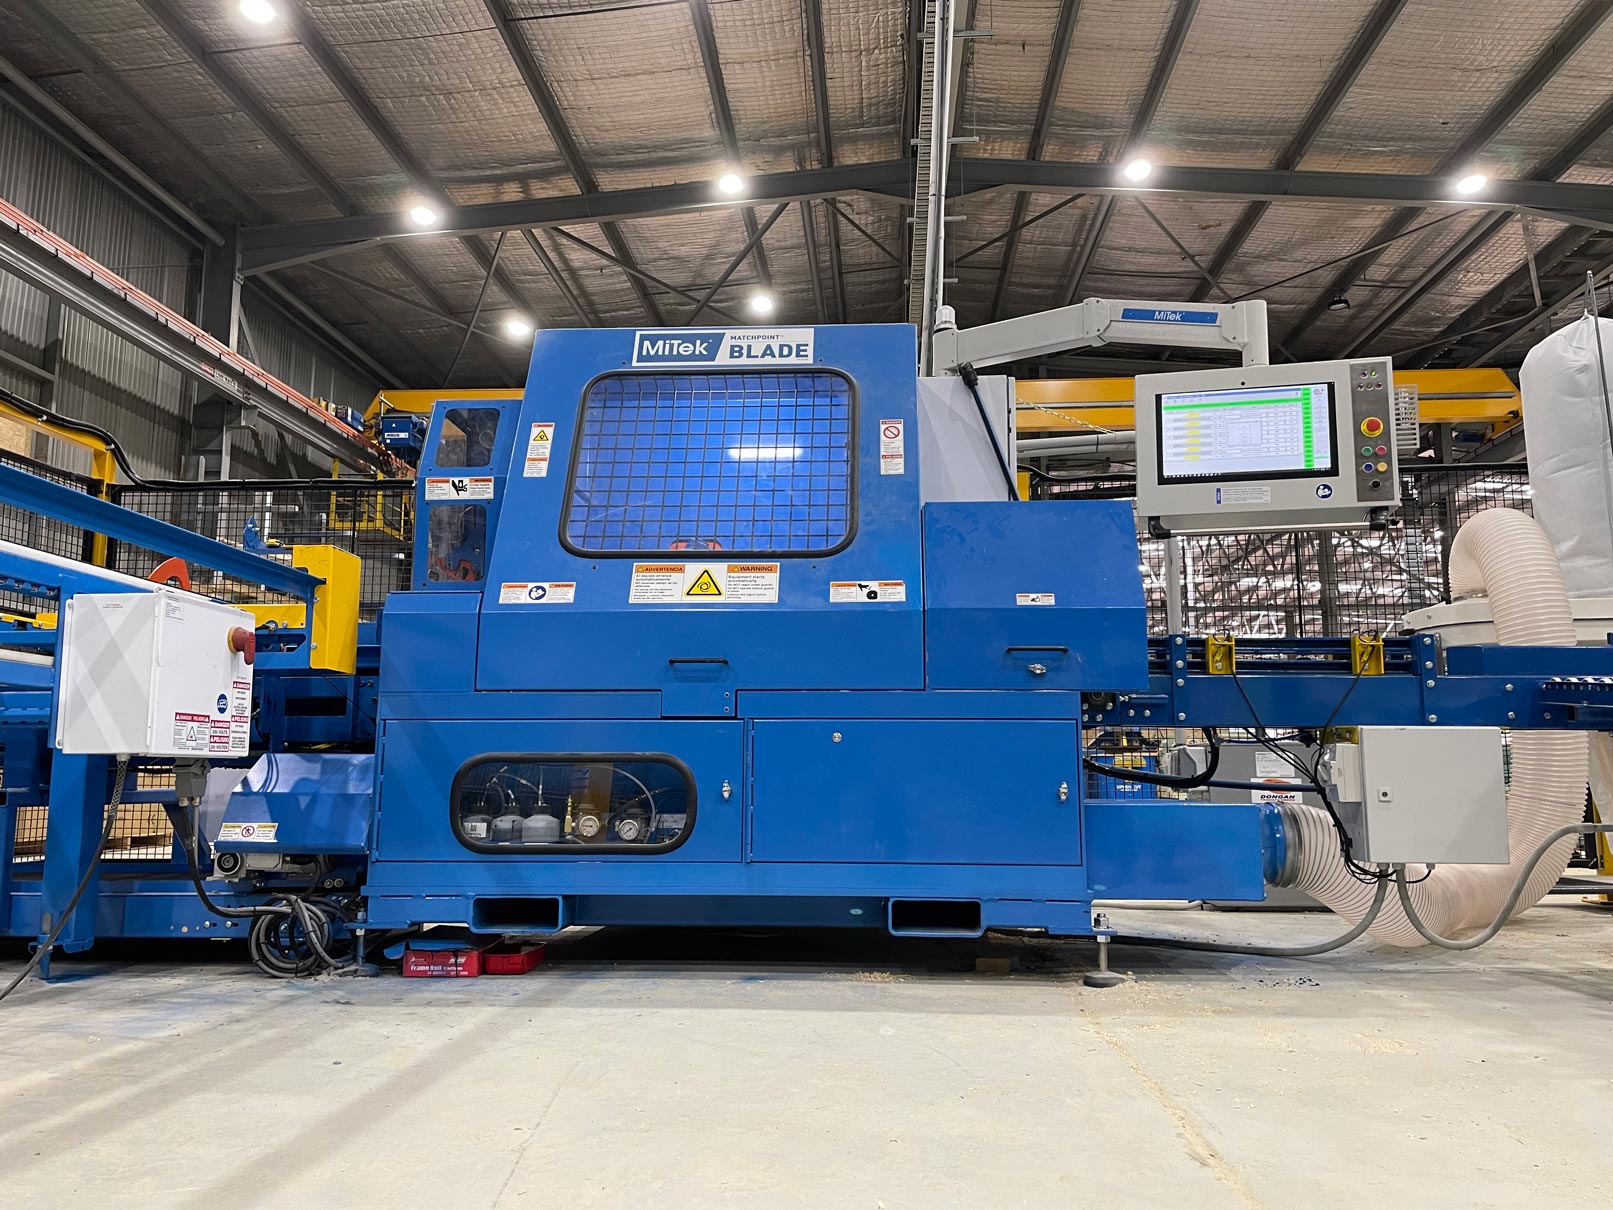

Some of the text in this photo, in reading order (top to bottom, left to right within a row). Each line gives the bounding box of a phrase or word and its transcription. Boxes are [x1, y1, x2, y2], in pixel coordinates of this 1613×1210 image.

[1154, 311, 1182, 321] MiTek
[642, 339, 709, 356] MiTek
[728, 343, 809, 359] BLADE
